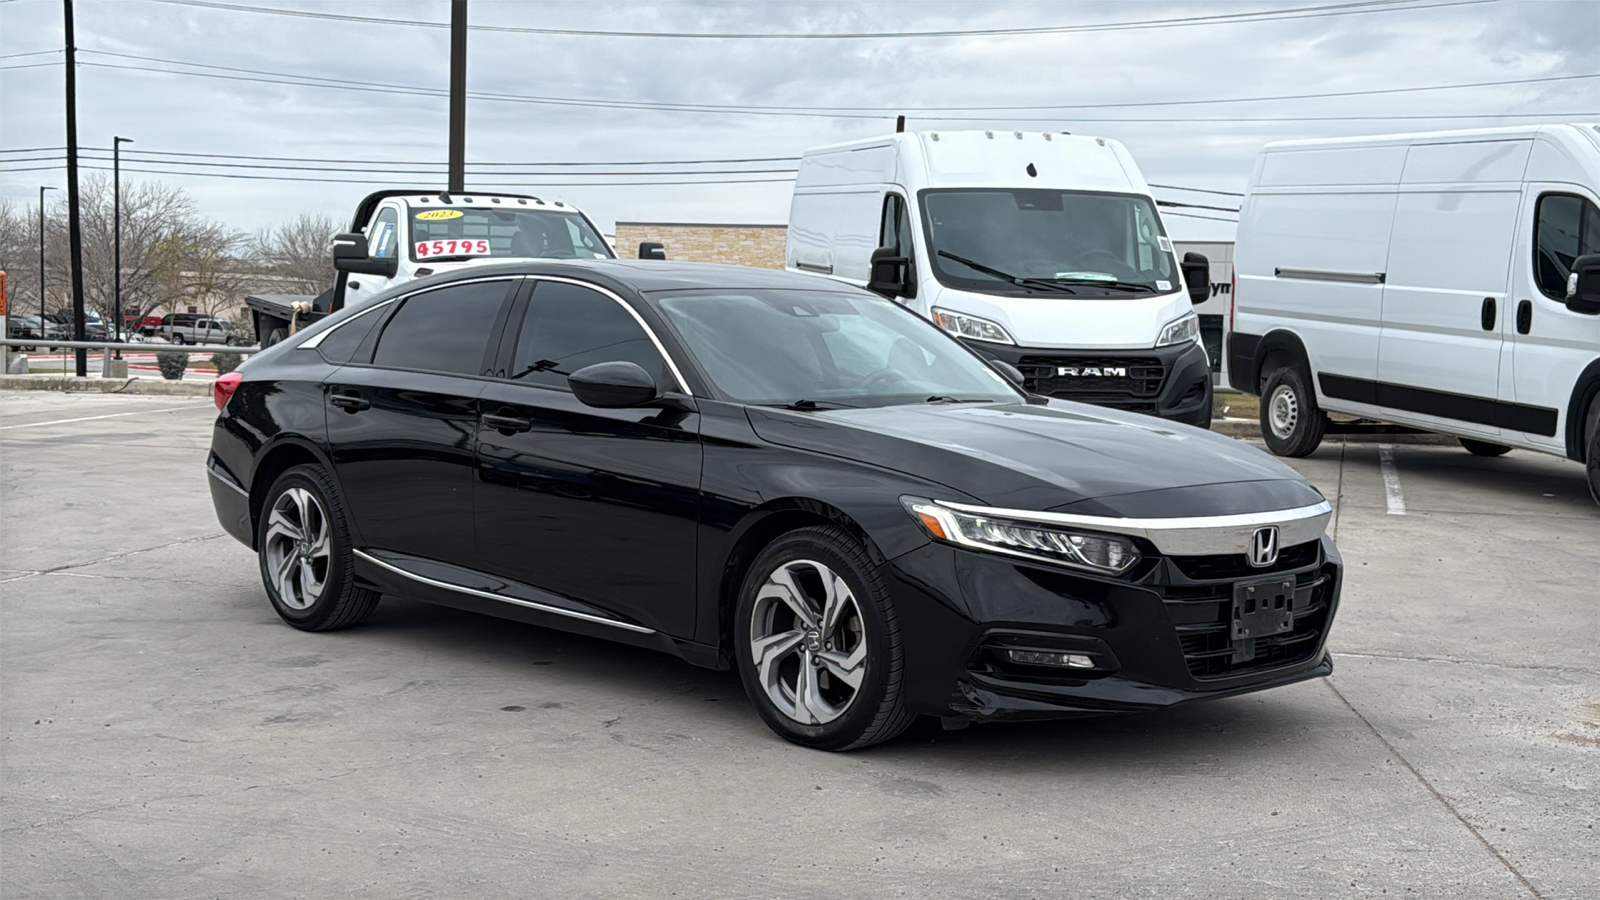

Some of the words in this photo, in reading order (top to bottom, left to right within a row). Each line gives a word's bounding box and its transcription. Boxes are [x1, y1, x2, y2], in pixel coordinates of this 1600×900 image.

[423, 211, 454, 219] 2023
[417, 240, 488, 257] 45795
[1058, 366, 1126, 377] RAM
